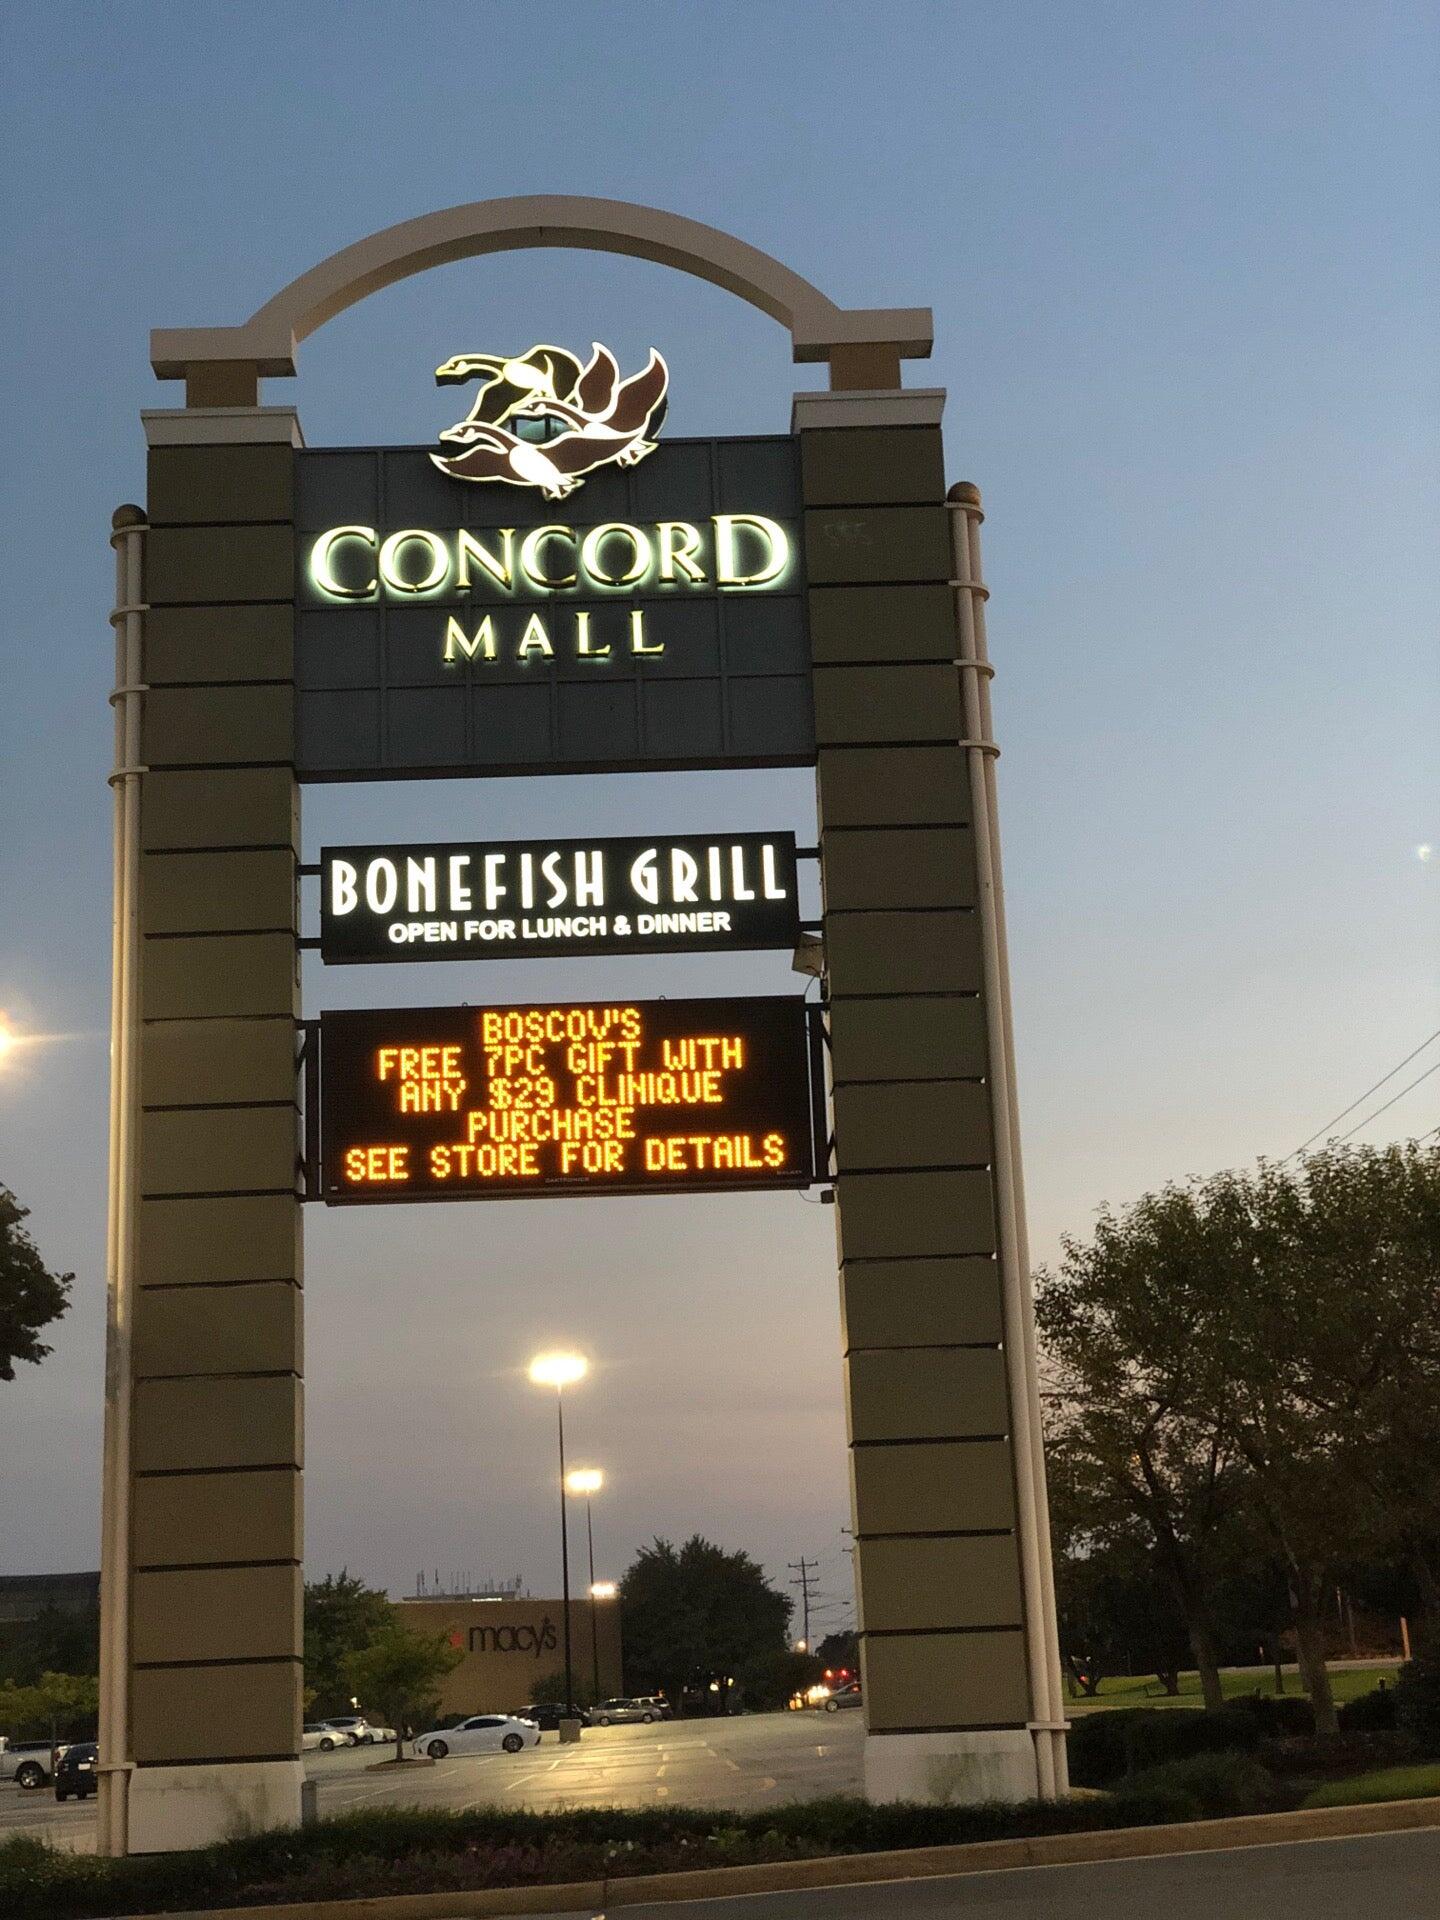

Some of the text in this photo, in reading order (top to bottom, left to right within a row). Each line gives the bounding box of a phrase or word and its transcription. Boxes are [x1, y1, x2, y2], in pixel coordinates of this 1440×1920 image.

[310, 514, 789, 599] CONCORD
[443, 610, 665, 662] MALL
[332, 844, 787, 916] BONEFISH GRILL
[388, 911, 732, 944] OPEN FOR LUNCH & DINNER
[483, 1008, 641, 1044] BOSCOV'S
[379, 1037, 743, 1080] FREE 7PC GIFT WITH
[401, 1070, 723, 1113] ANY $29 CLINIQUE
[468, 1107, 636, 1143] PURCHASE
[346, 1134, 784, 1181] SEE STORE FOR DETAILS
[469, 1616, 557, 1659] macy's
